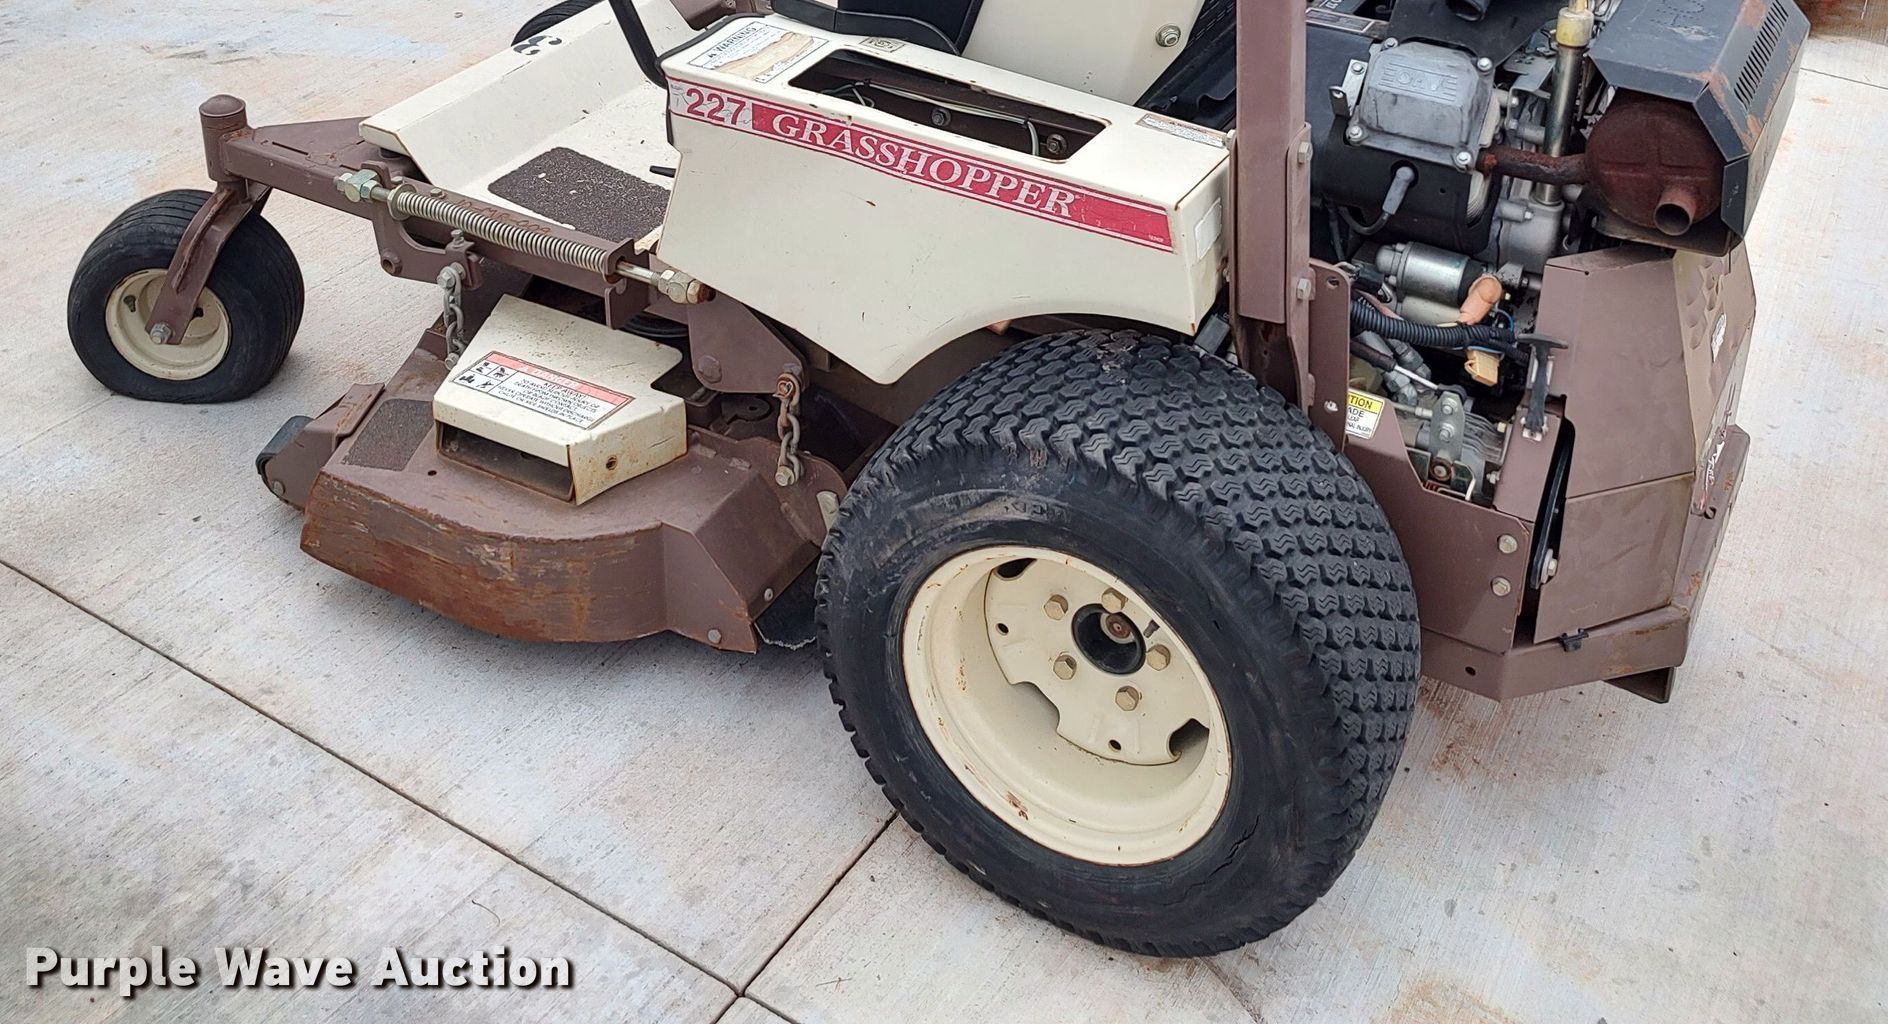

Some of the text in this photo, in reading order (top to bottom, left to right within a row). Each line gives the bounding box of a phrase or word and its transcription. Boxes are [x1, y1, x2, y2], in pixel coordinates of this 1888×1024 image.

[686, 87, 747, 127] 227
[771, 114, 1076, 218] GRASSHOPPER
[1350, 395, 1373, 410] TION
